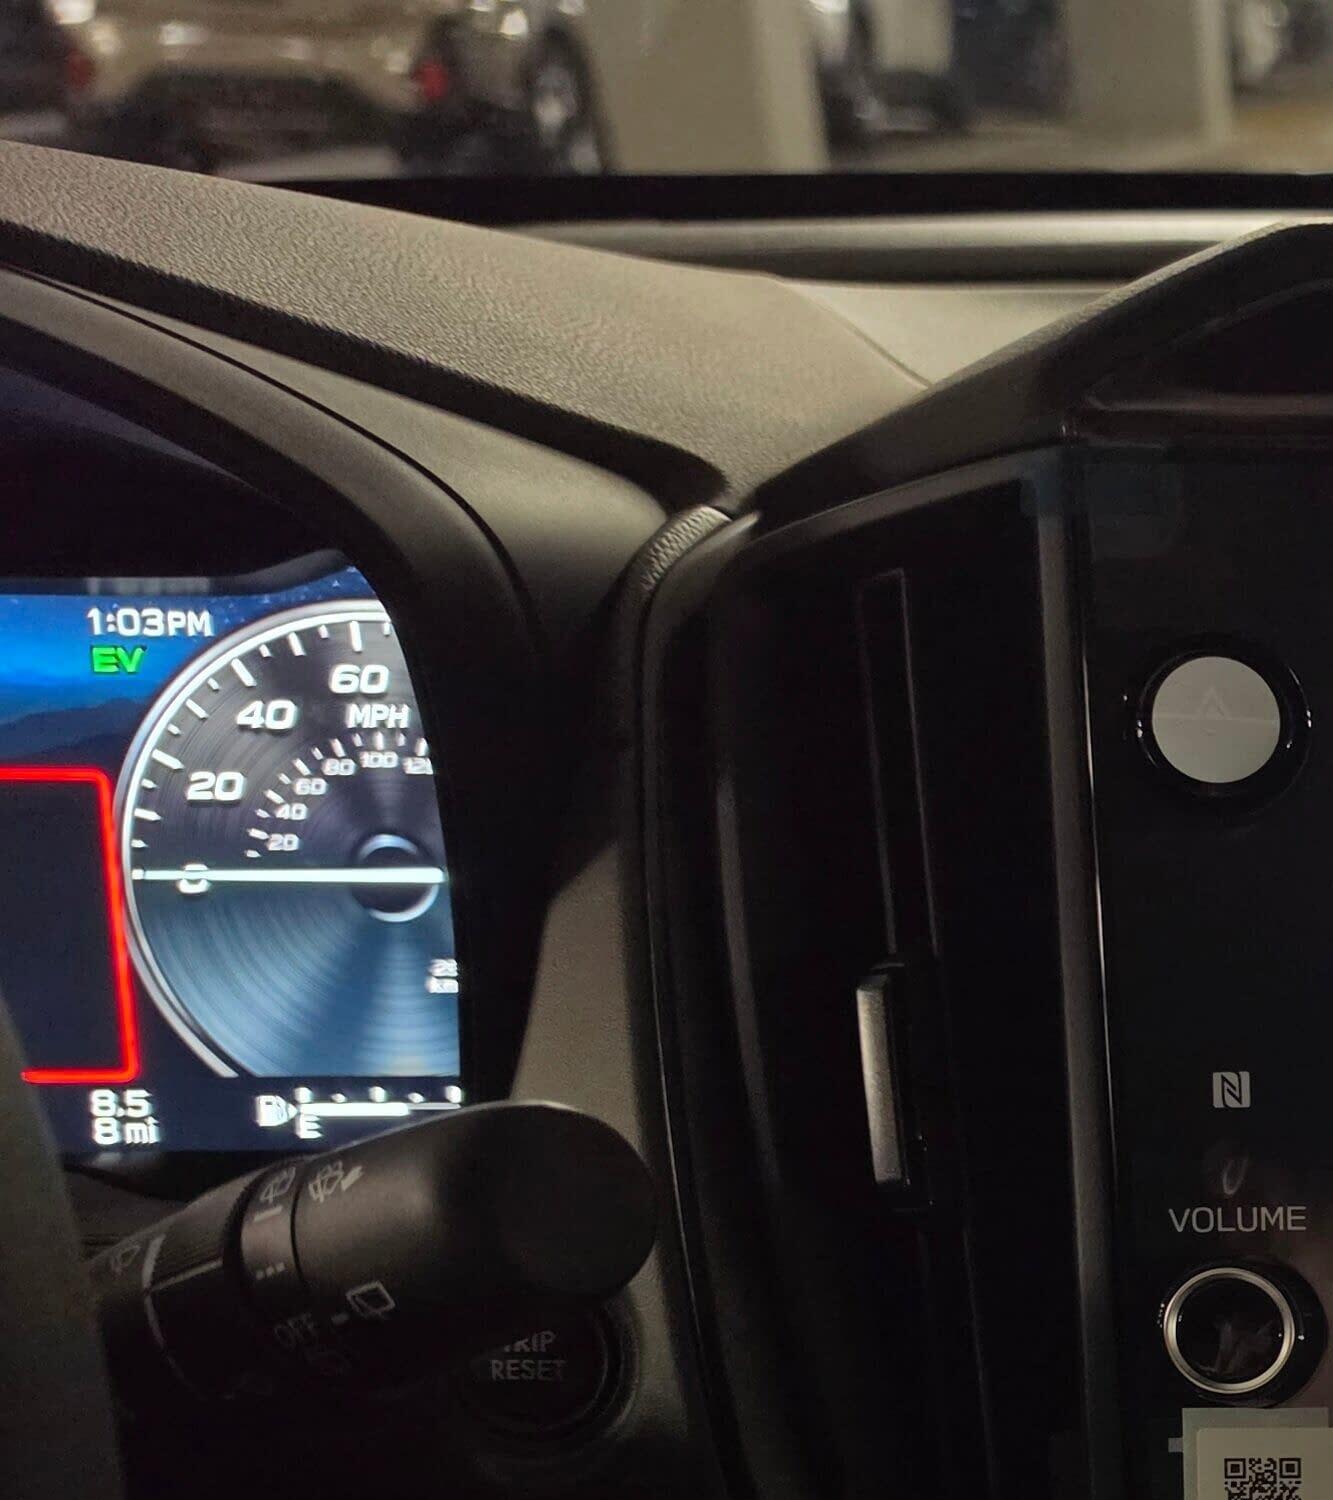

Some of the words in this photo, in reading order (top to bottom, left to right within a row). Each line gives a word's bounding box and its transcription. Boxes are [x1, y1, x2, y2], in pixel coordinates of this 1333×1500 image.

[92, 646, 146, 673] EV
[330, 664, 389, 694] 60
[236, 700, 297, 730] 40
[346, 704, 410, 728] MPH
[359, 751, 399, 769] 100
[186, 771, 246, 801] 20
[275, 803, 308, 820] 40
[266, 833, 300, 851] 20
[90, 1089, 152, 1118] 8.5
[94, 1117, 121, 1145] 8
[124, 1116, 161, 1144] mi
[295, 1113, 323, 1140] E
[1168, 1206, 1307, 1233] VOLUME
[490, 1359, 568, 1382] RESET
